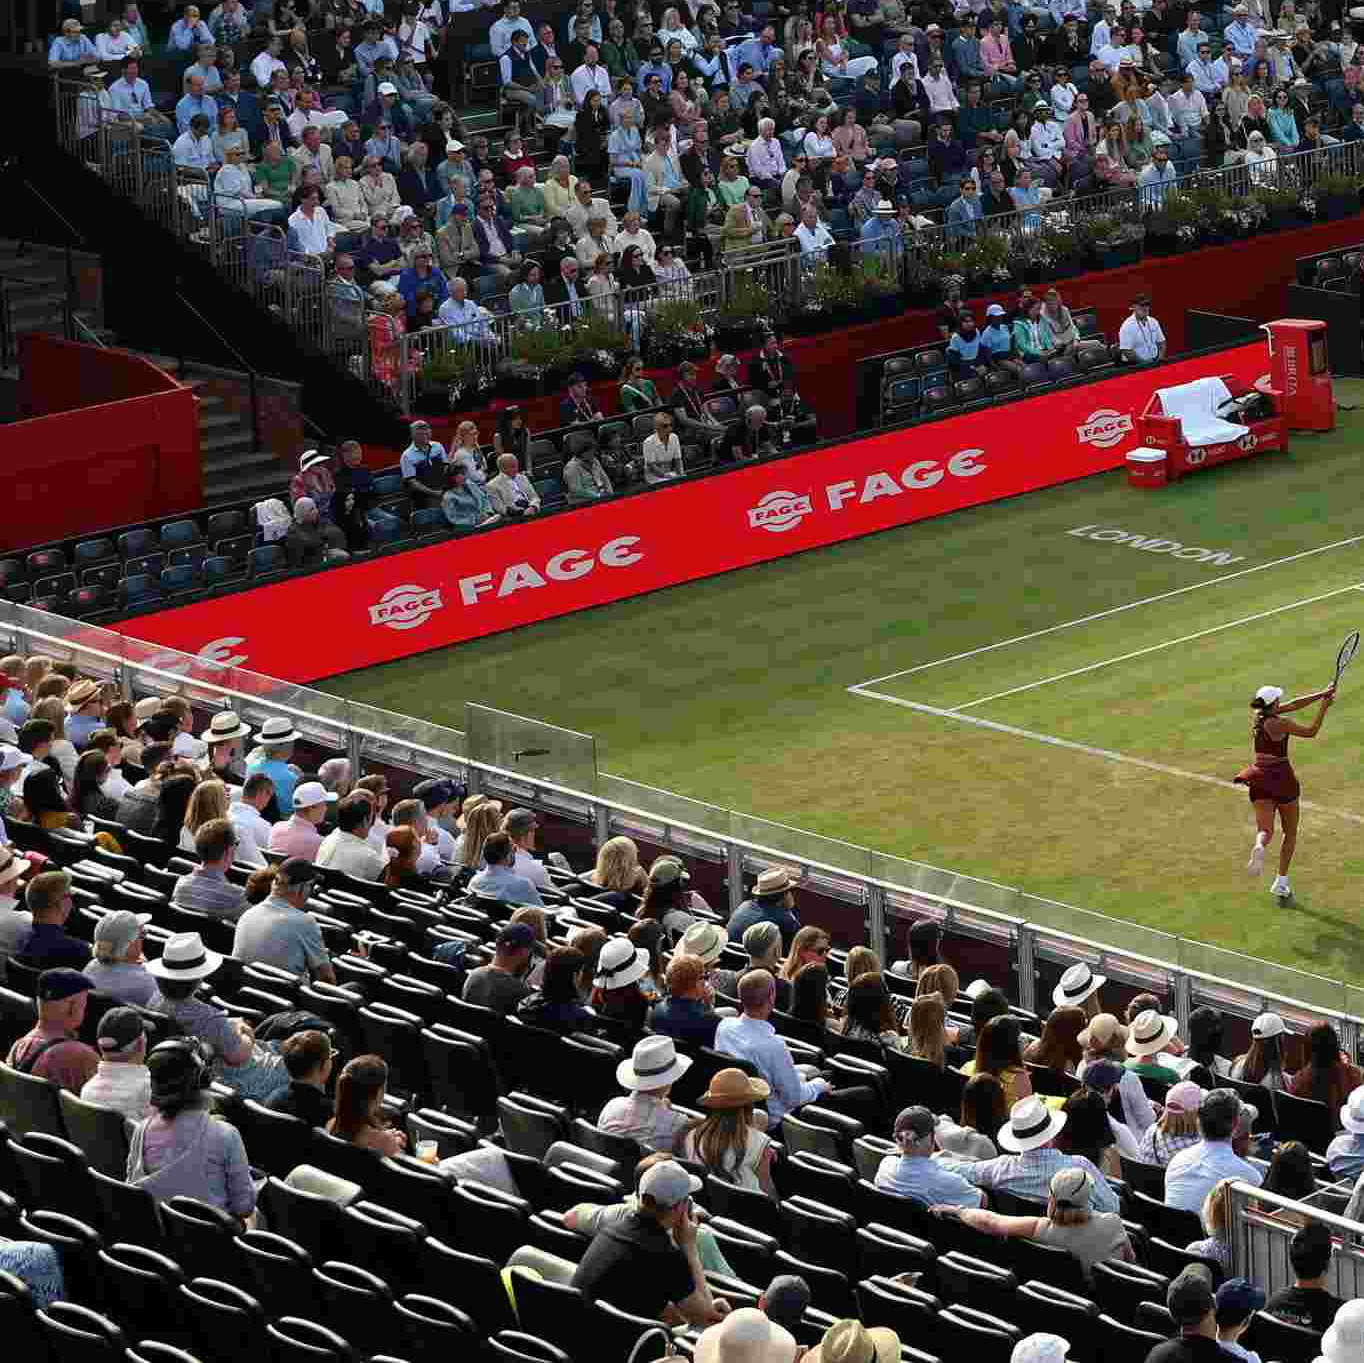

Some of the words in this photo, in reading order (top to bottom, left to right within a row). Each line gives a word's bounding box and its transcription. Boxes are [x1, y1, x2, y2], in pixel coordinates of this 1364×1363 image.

[825, 449, 988, 511] FAGE
[458, 536, 646, 606] FAGE
[1064, 524, 1246, 566] LONDON
